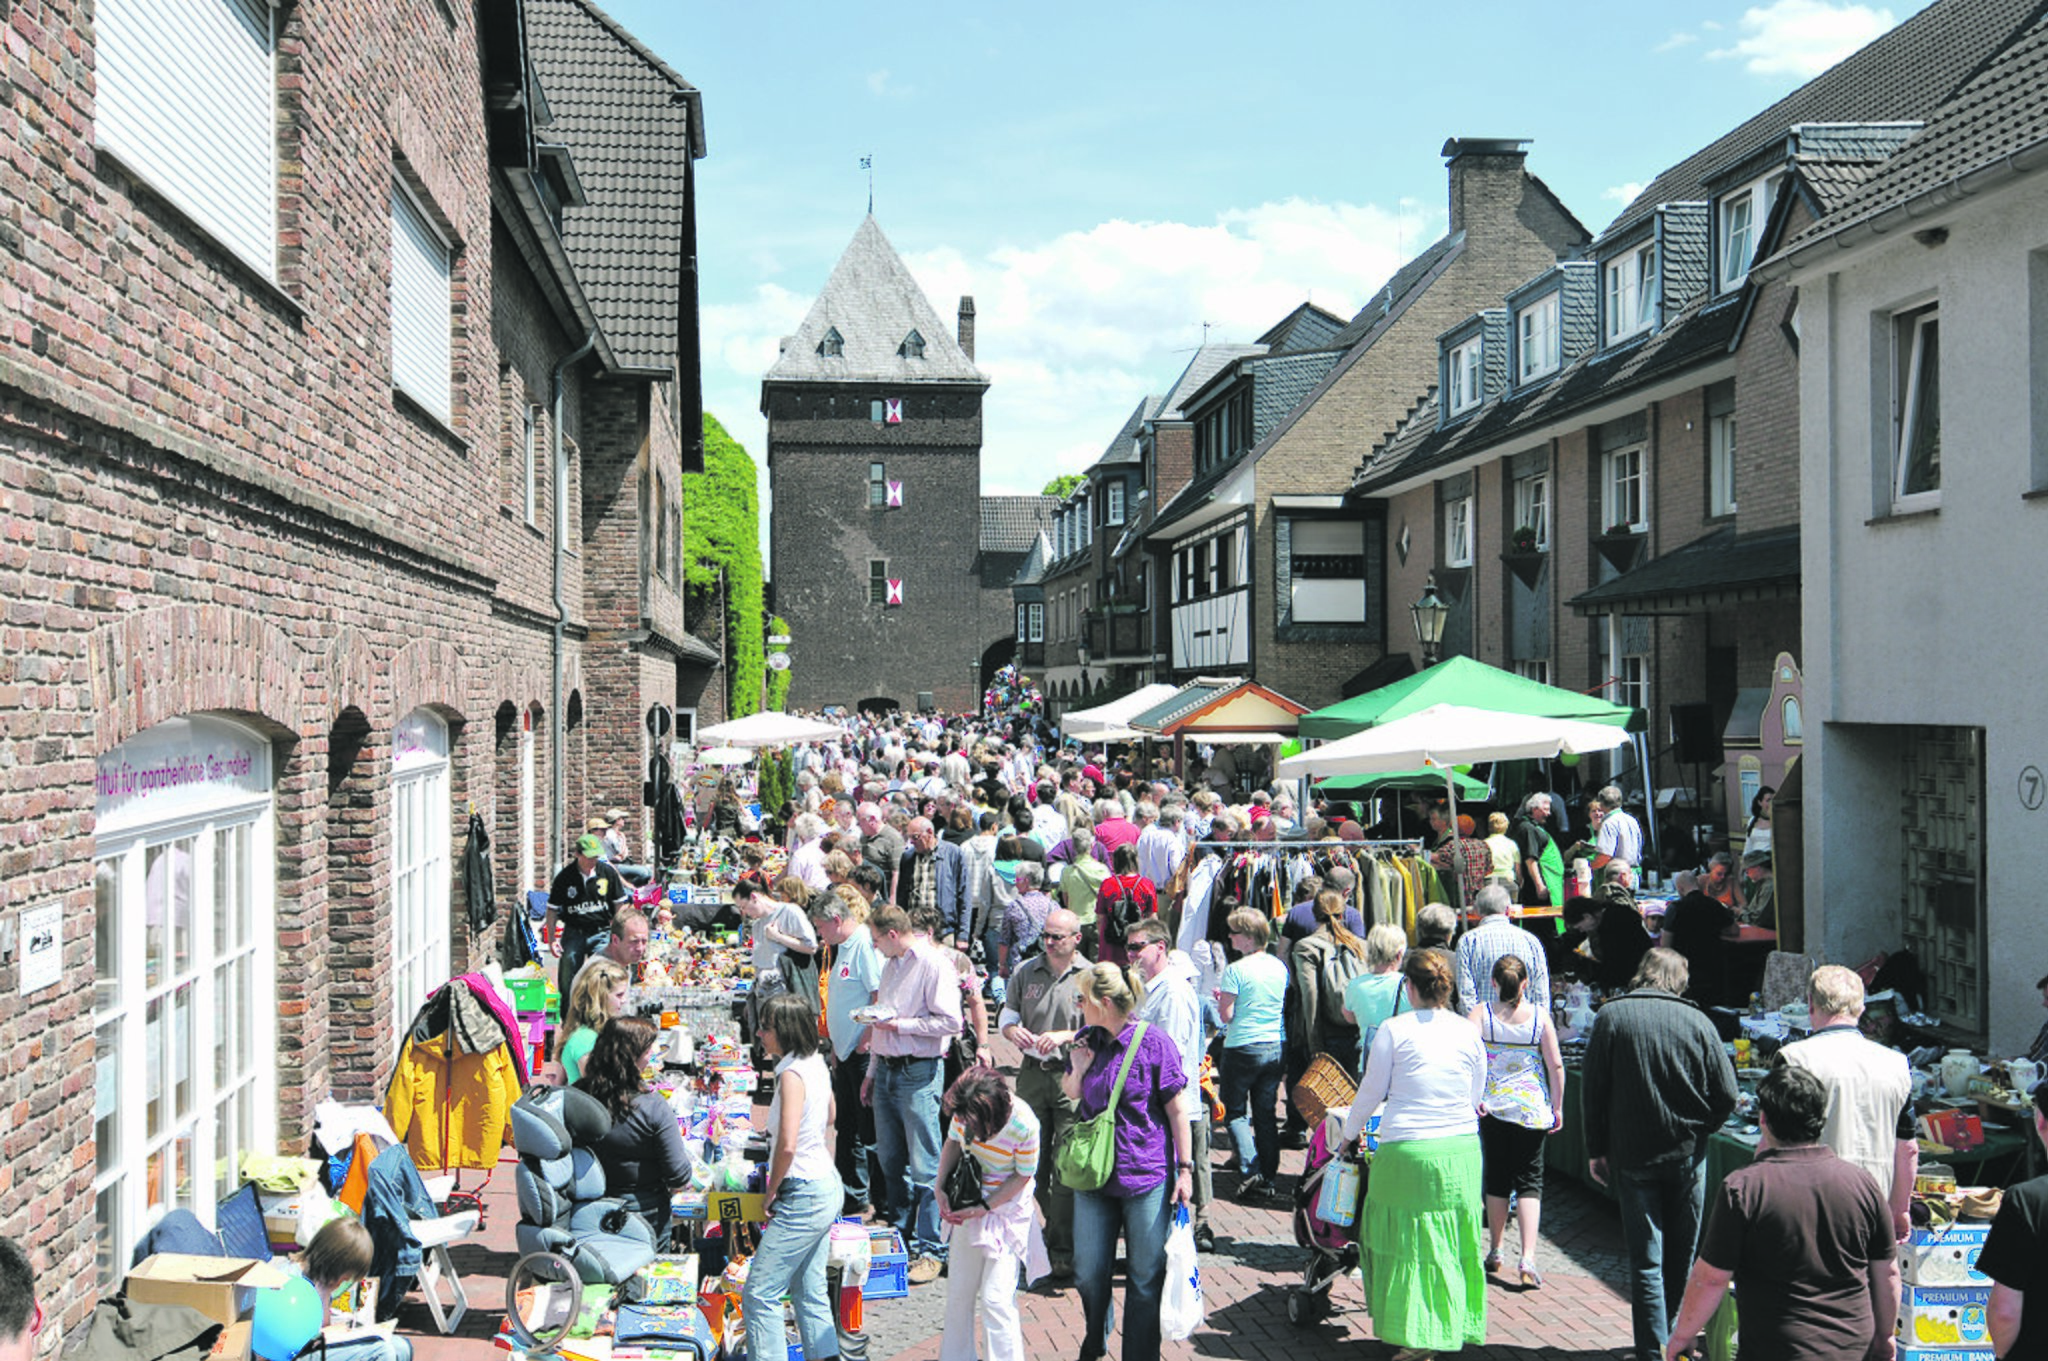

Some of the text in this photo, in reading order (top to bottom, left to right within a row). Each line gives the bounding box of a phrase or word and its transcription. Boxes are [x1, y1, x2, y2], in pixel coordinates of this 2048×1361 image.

[121, 760, 138, 793] für
[141, 753, 204, 798] ganzheitliche
[2025, 775, 2039, 805] 7
[1922, 1292, 1968, 1303] PREMIUM
